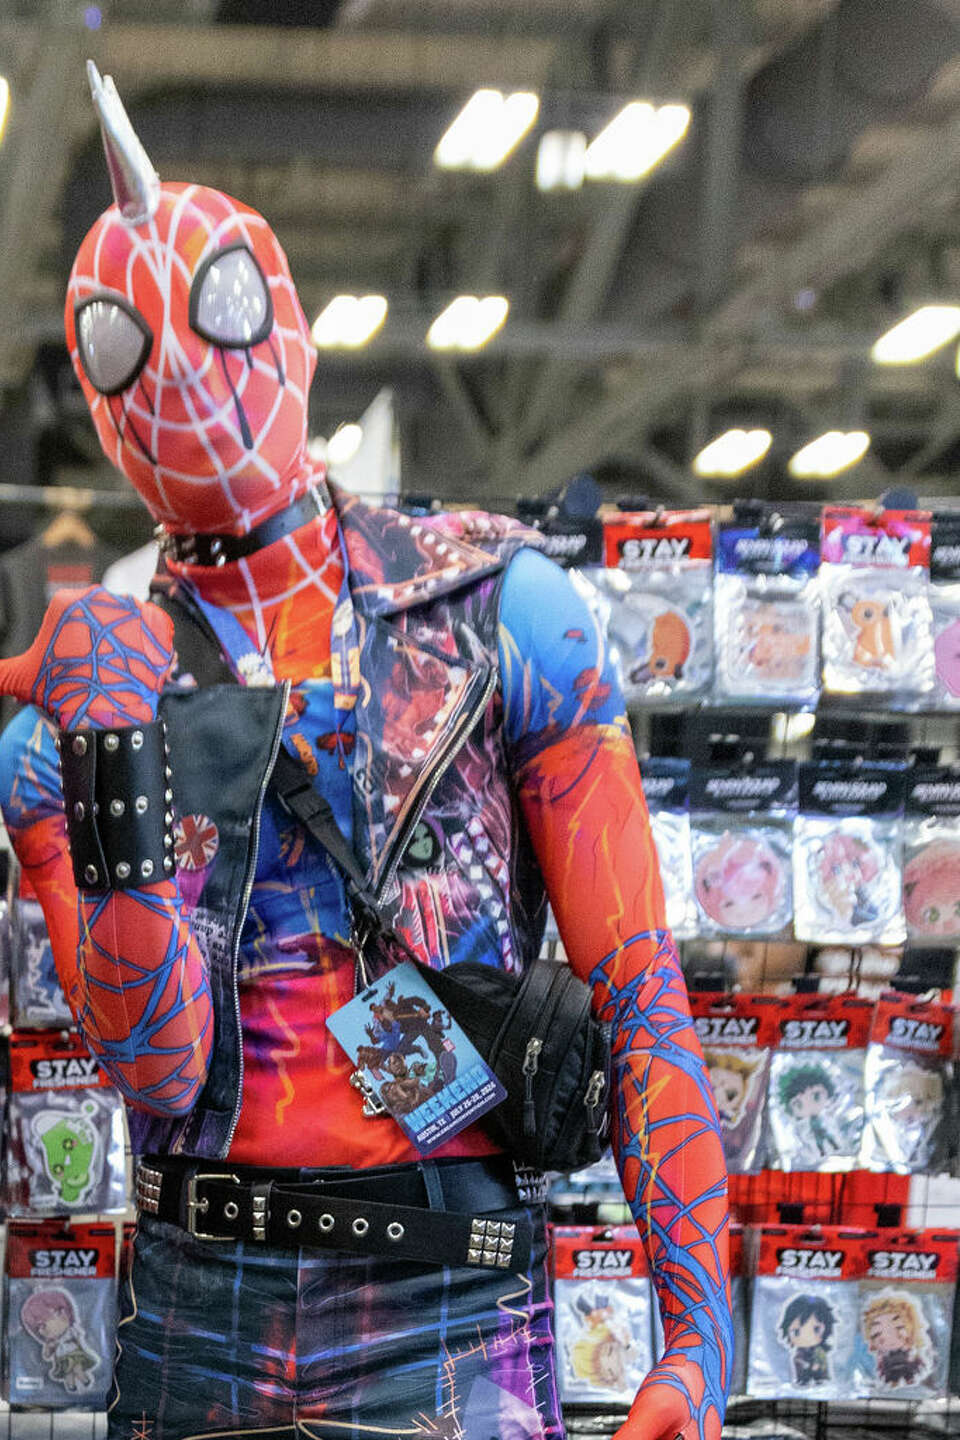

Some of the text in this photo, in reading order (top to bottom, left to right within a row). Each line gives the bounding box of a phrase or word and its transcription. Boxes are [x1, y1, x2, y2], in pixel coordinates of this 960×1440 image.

[623, 538, 689, 560] STAY
[846, 533, 908, 556] STAY
[695, 1018, 756, 1037] STAY
[785, 1020, 847, 1040] STAY
[892, 1018, 942, 1040] STAY
[37, 1058, 96, 1080] STAY
[36, 1250, 95, 1268] STAY
[577, 1250, 632, 1270] STAY
[781, 1250, 841, 1268] STAY
[873, 1252, 936, 1270] STAY
